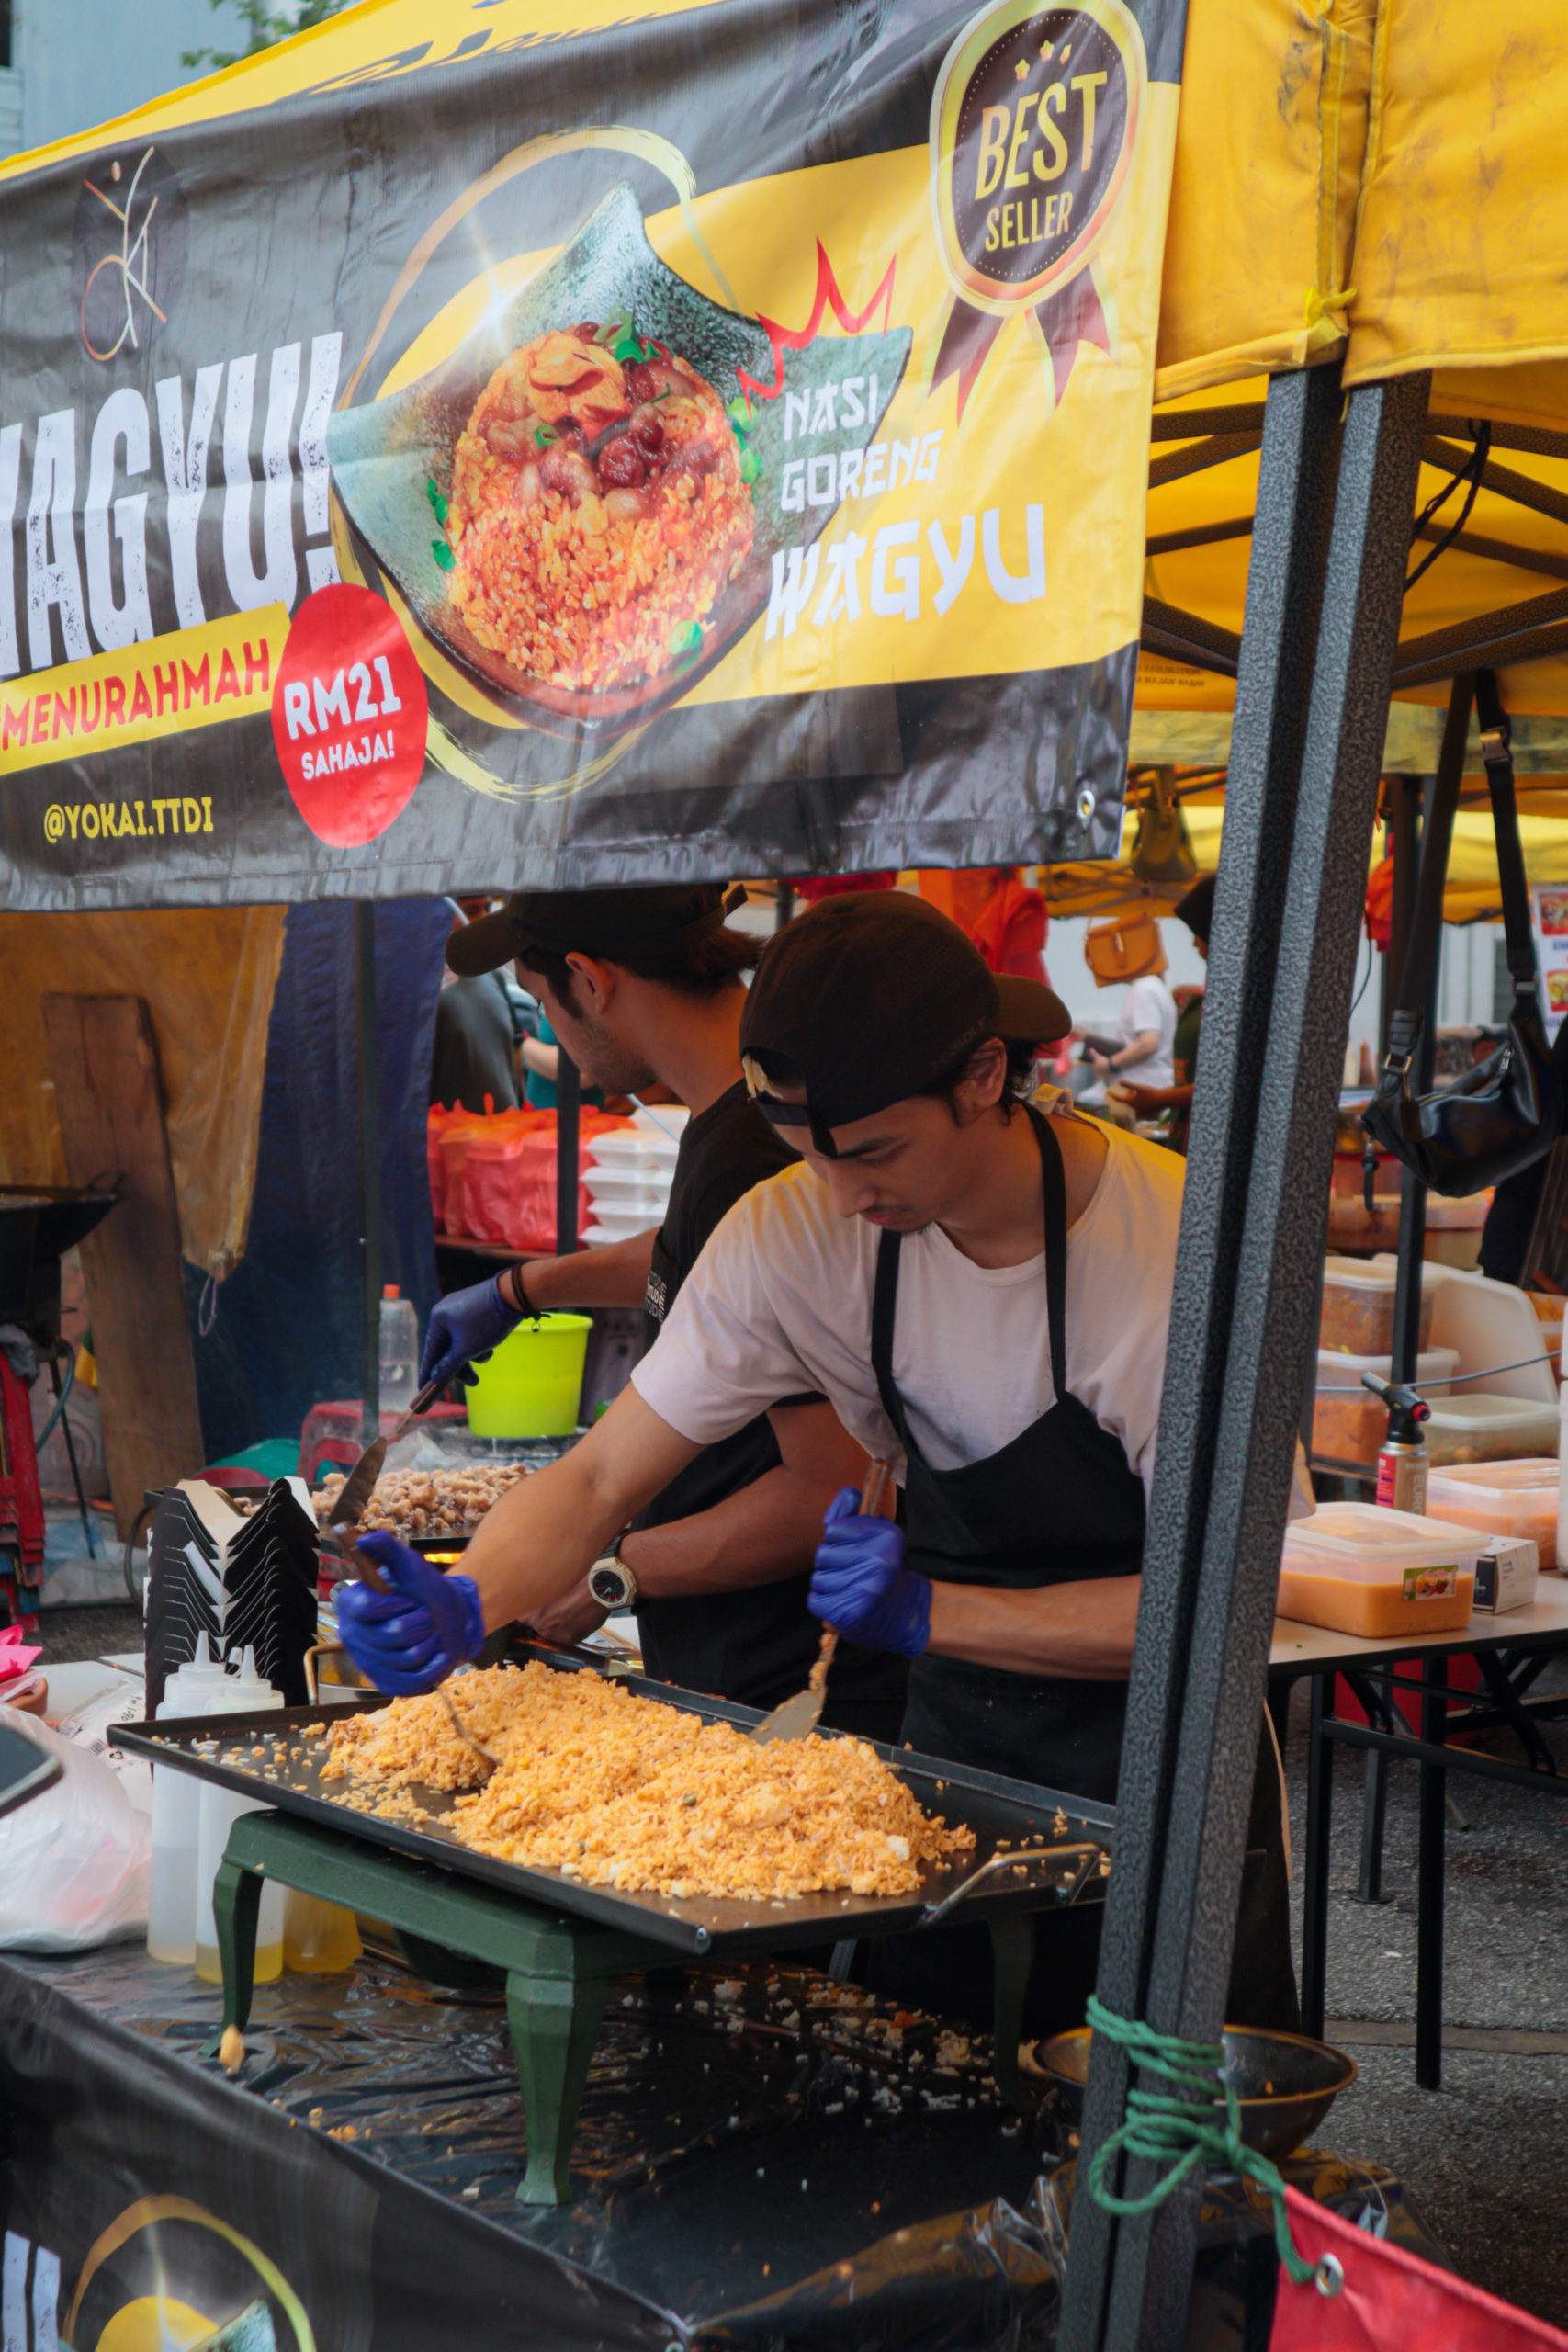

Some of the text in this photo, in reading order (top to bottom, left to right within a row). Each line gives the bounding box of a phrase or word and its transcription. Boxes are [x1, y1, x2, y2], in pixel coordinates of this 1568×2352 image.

[975, 71, 1108, 201] BEST
[985, 190, 1074, 253] SELLER
[784, 372, 878, 442] NASI
[780, 427, 944, 514] GORENG
[764, 503, 1046, 642] WAGYU
[0, 637, 271, 751] MENURAHMAH
[283, 654, 403, 741] RM21
[300, 729, 396, 781] SAHAJA!
[44, 796, 215, 844] @YOKAI.TTDI
